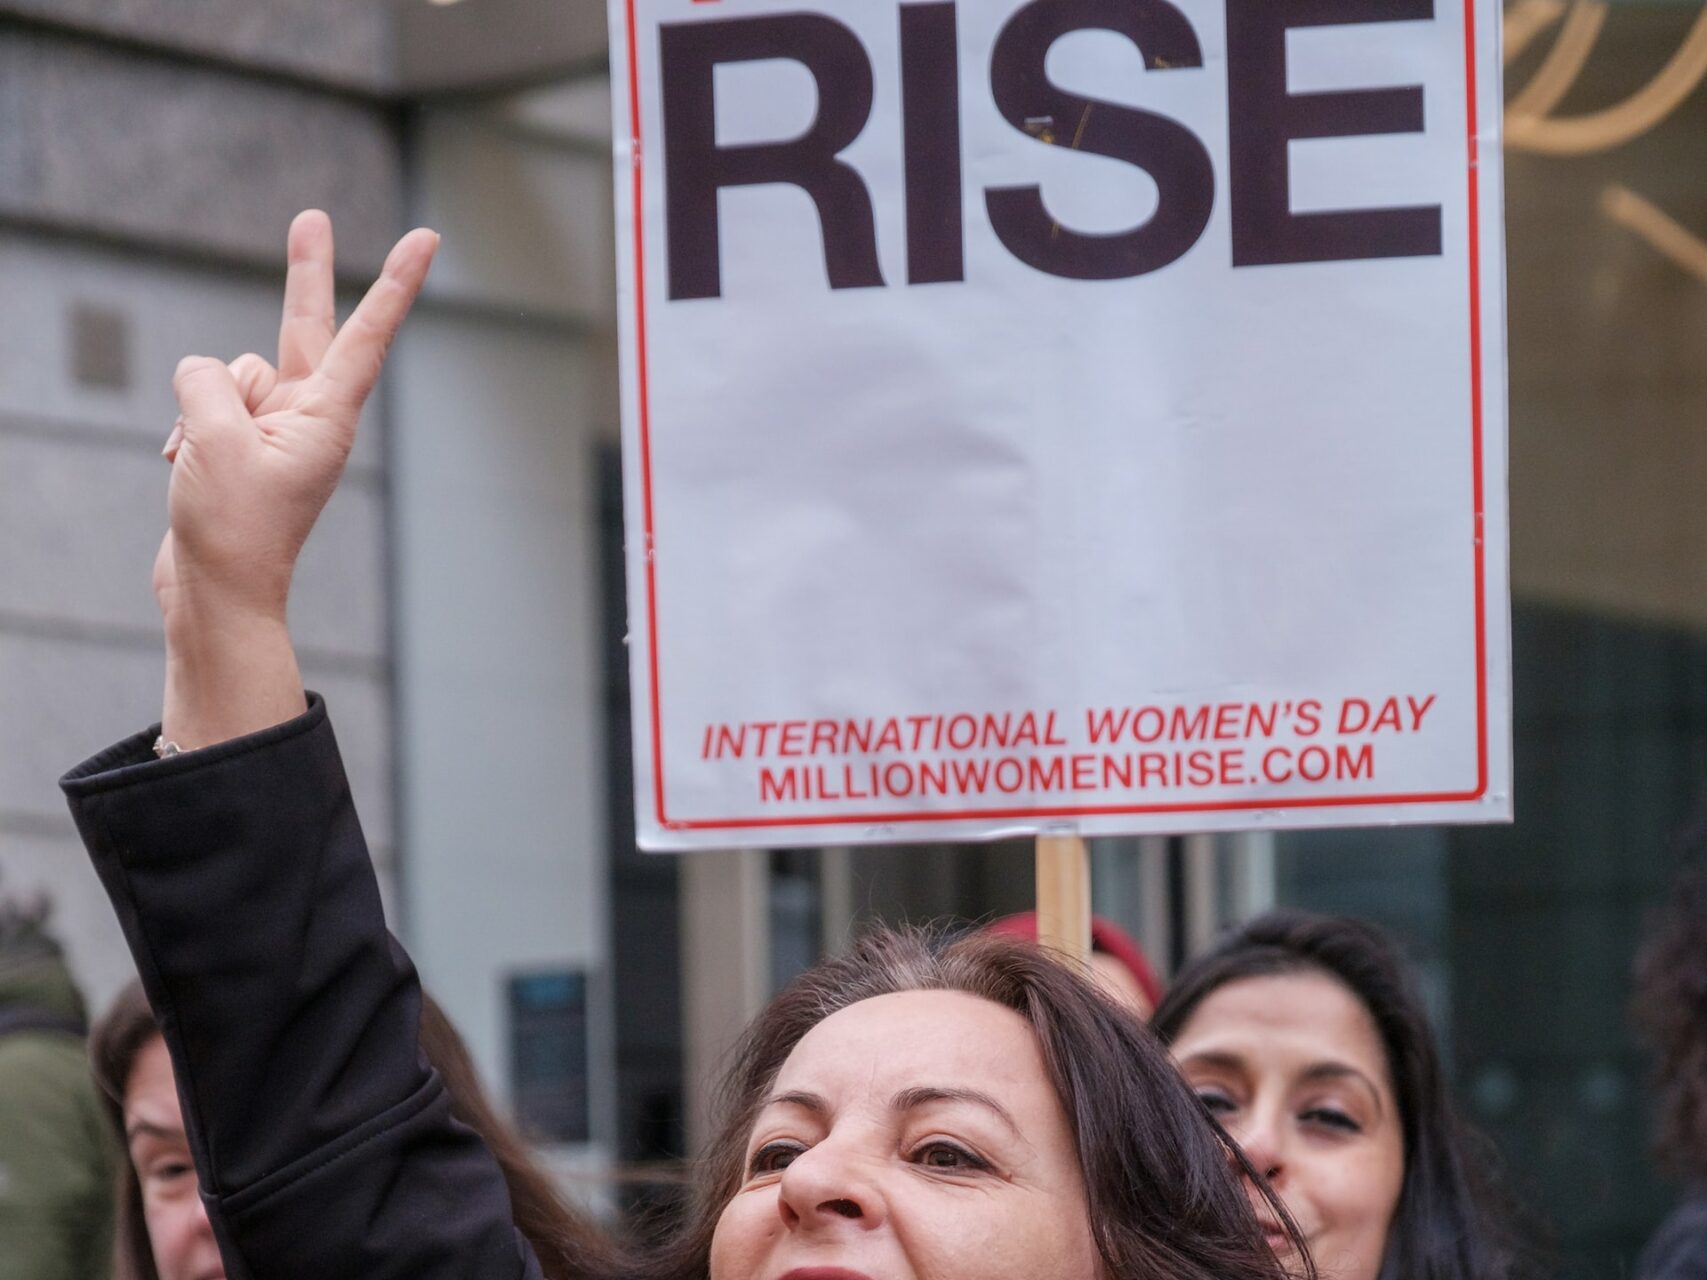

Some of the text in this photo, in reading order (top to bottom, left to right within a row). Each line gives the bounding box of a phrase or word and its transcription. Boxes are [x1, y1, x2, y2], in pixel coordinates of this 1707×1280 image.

[658, 0, 1444, 301] RISE
[701, 693, 1437, 760] INTERNATIONAL WOMEN'S DAY
[759, 743, 1374, 802] MILLIONWOMENRISE.COM
